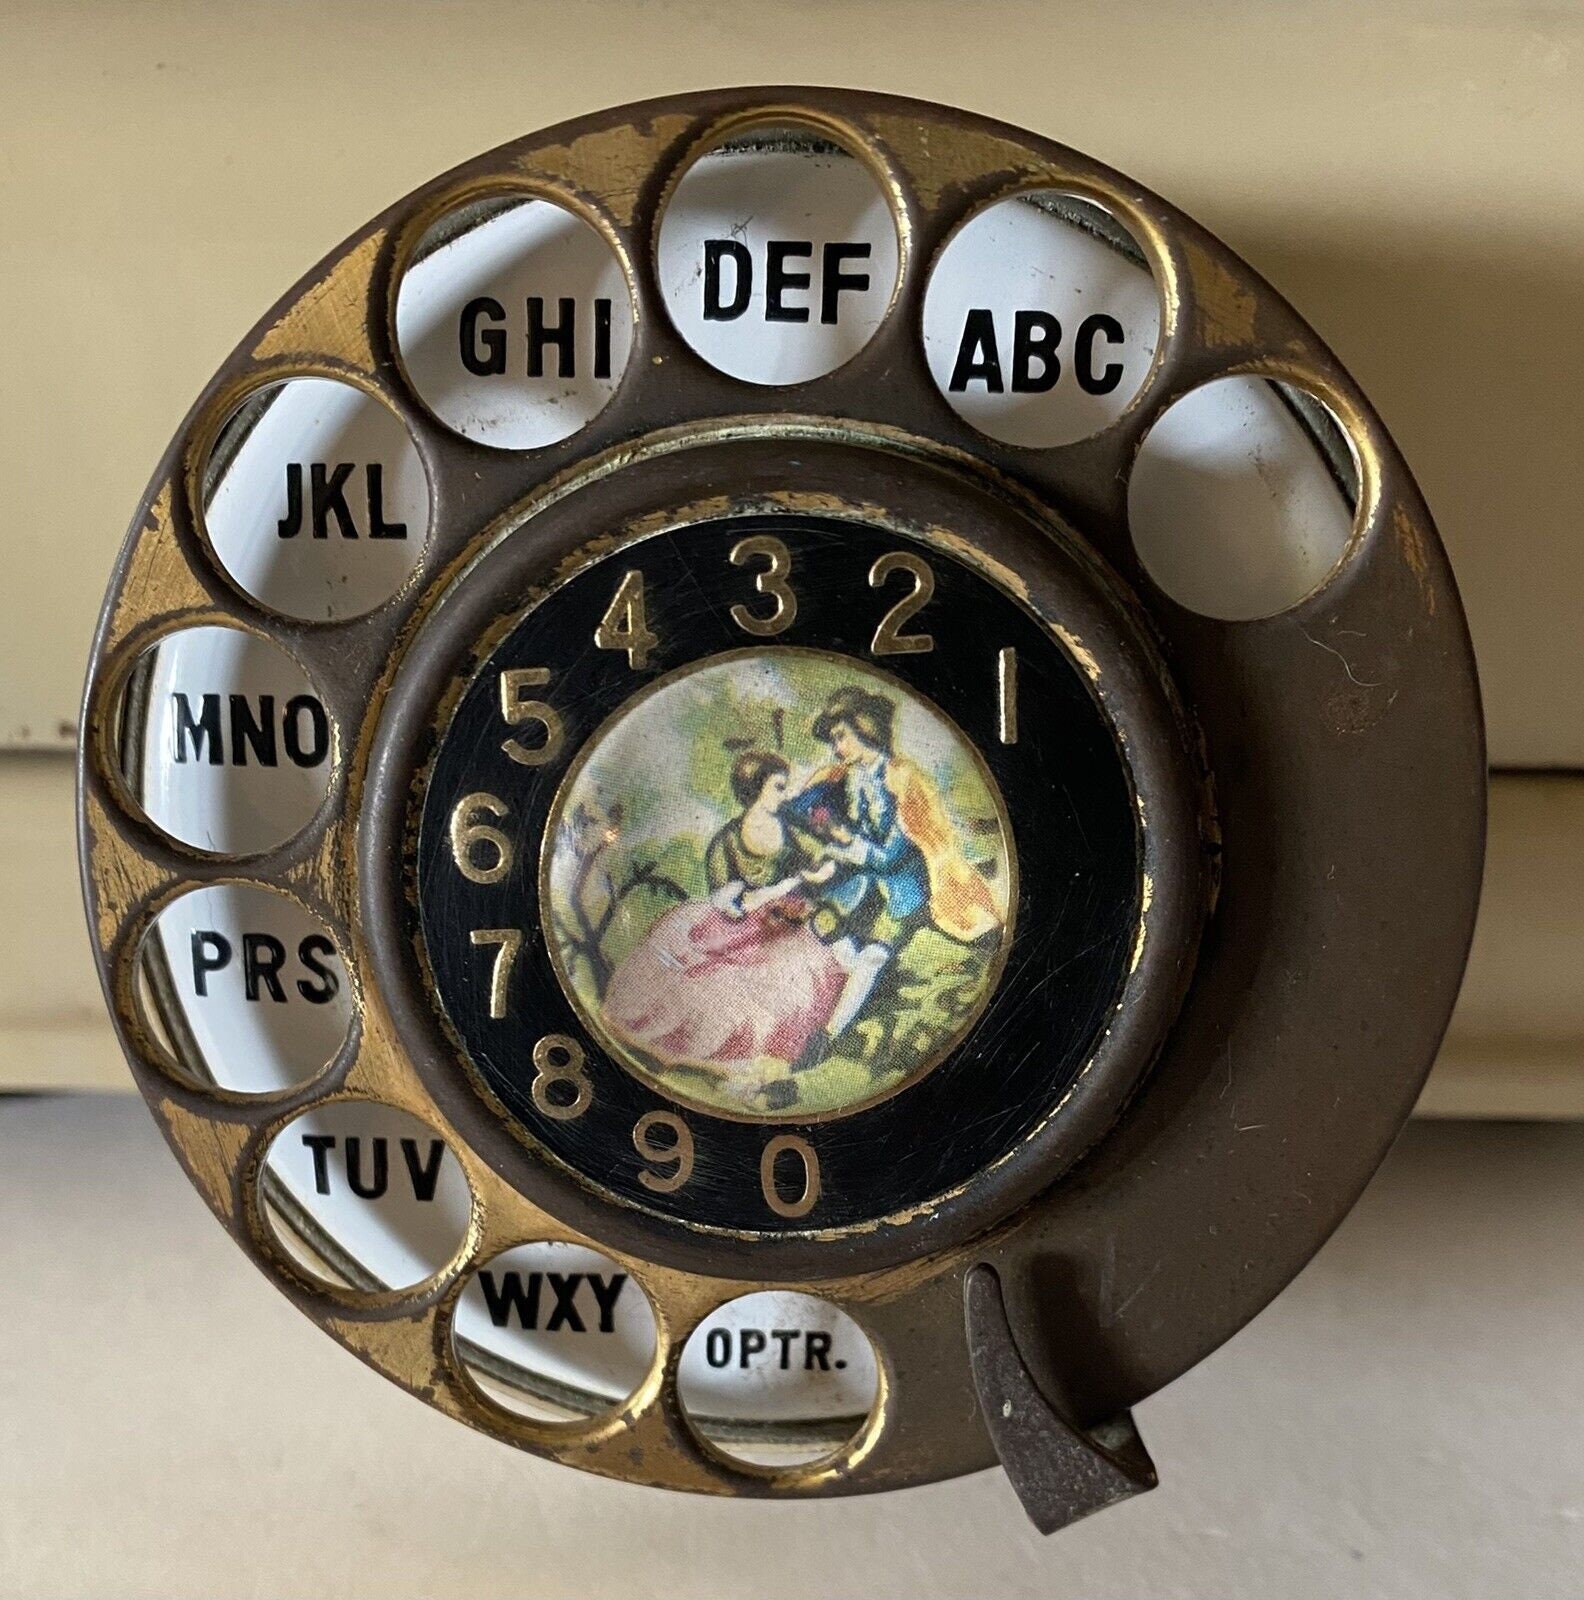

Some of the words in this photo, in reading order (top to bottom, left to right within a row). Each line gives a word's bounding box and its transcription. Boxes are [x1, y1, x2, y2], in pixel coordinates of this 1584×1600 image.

[703, 239, 872, 325] DEF
[458, 296, 613, 379] GHI
[947, 309, 1125, 396] ABC
[277, 462, 408, 541] JKL
[594, 569, 658, 671] 4
[729, 535, 798, 636] 3
[868, 551, 936, 655] 2
[172, 693, 331, 769] MNO
[499, 667, 566, 766] 5
[998, 646, 1018, 745] 1
[450, 793, 514, 885] 6
[191, 930, 340, 1005] PRS
[469, 929, 523, 1020] 7
[532, 1033, 592, 1120] 8
[302, 1134, 446, 1202] TUV
[631, 1109, 696, 1193] 9
[760, 1134, 822, 1218] 0
[477, 1271, 629, 1335] WXY
[706, 1328, 847, 1372] OPTR.
